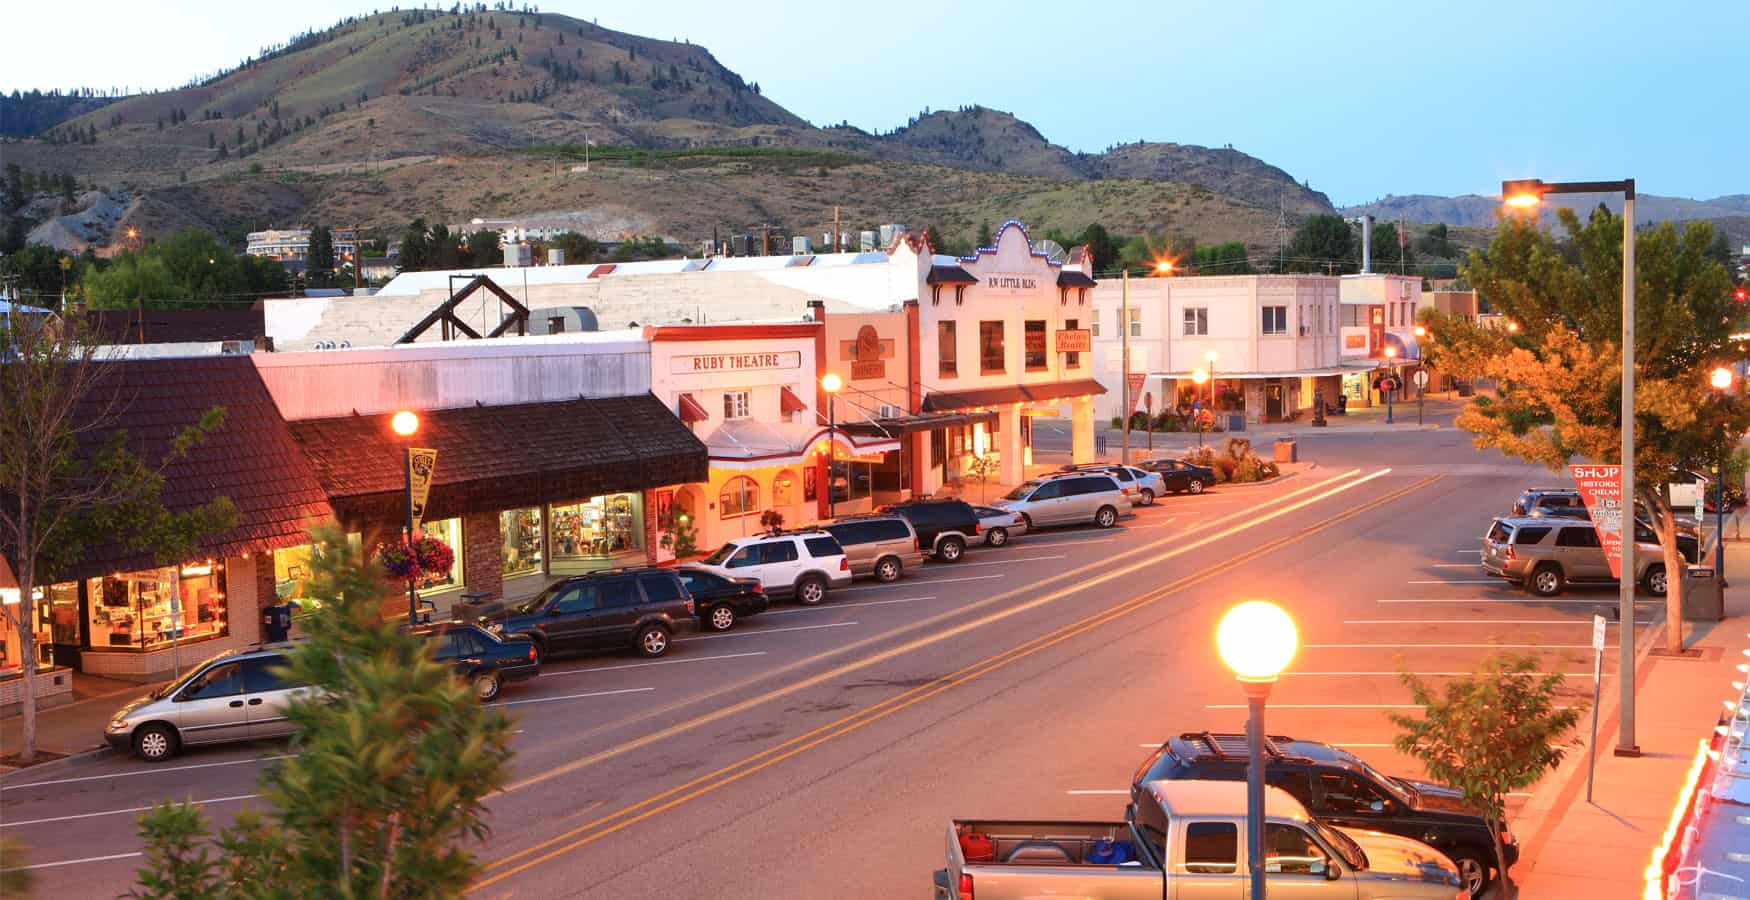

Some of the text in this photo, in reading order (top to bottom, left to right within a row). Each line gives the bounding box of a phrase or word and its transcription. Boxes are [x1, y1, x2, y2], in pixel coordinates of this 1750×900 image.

[1000, 278, 1020, 288] LITTLE
[693, 354, 780, 370] RUBY THEATRE
[1575, 467, 1619, 478] SHOP
